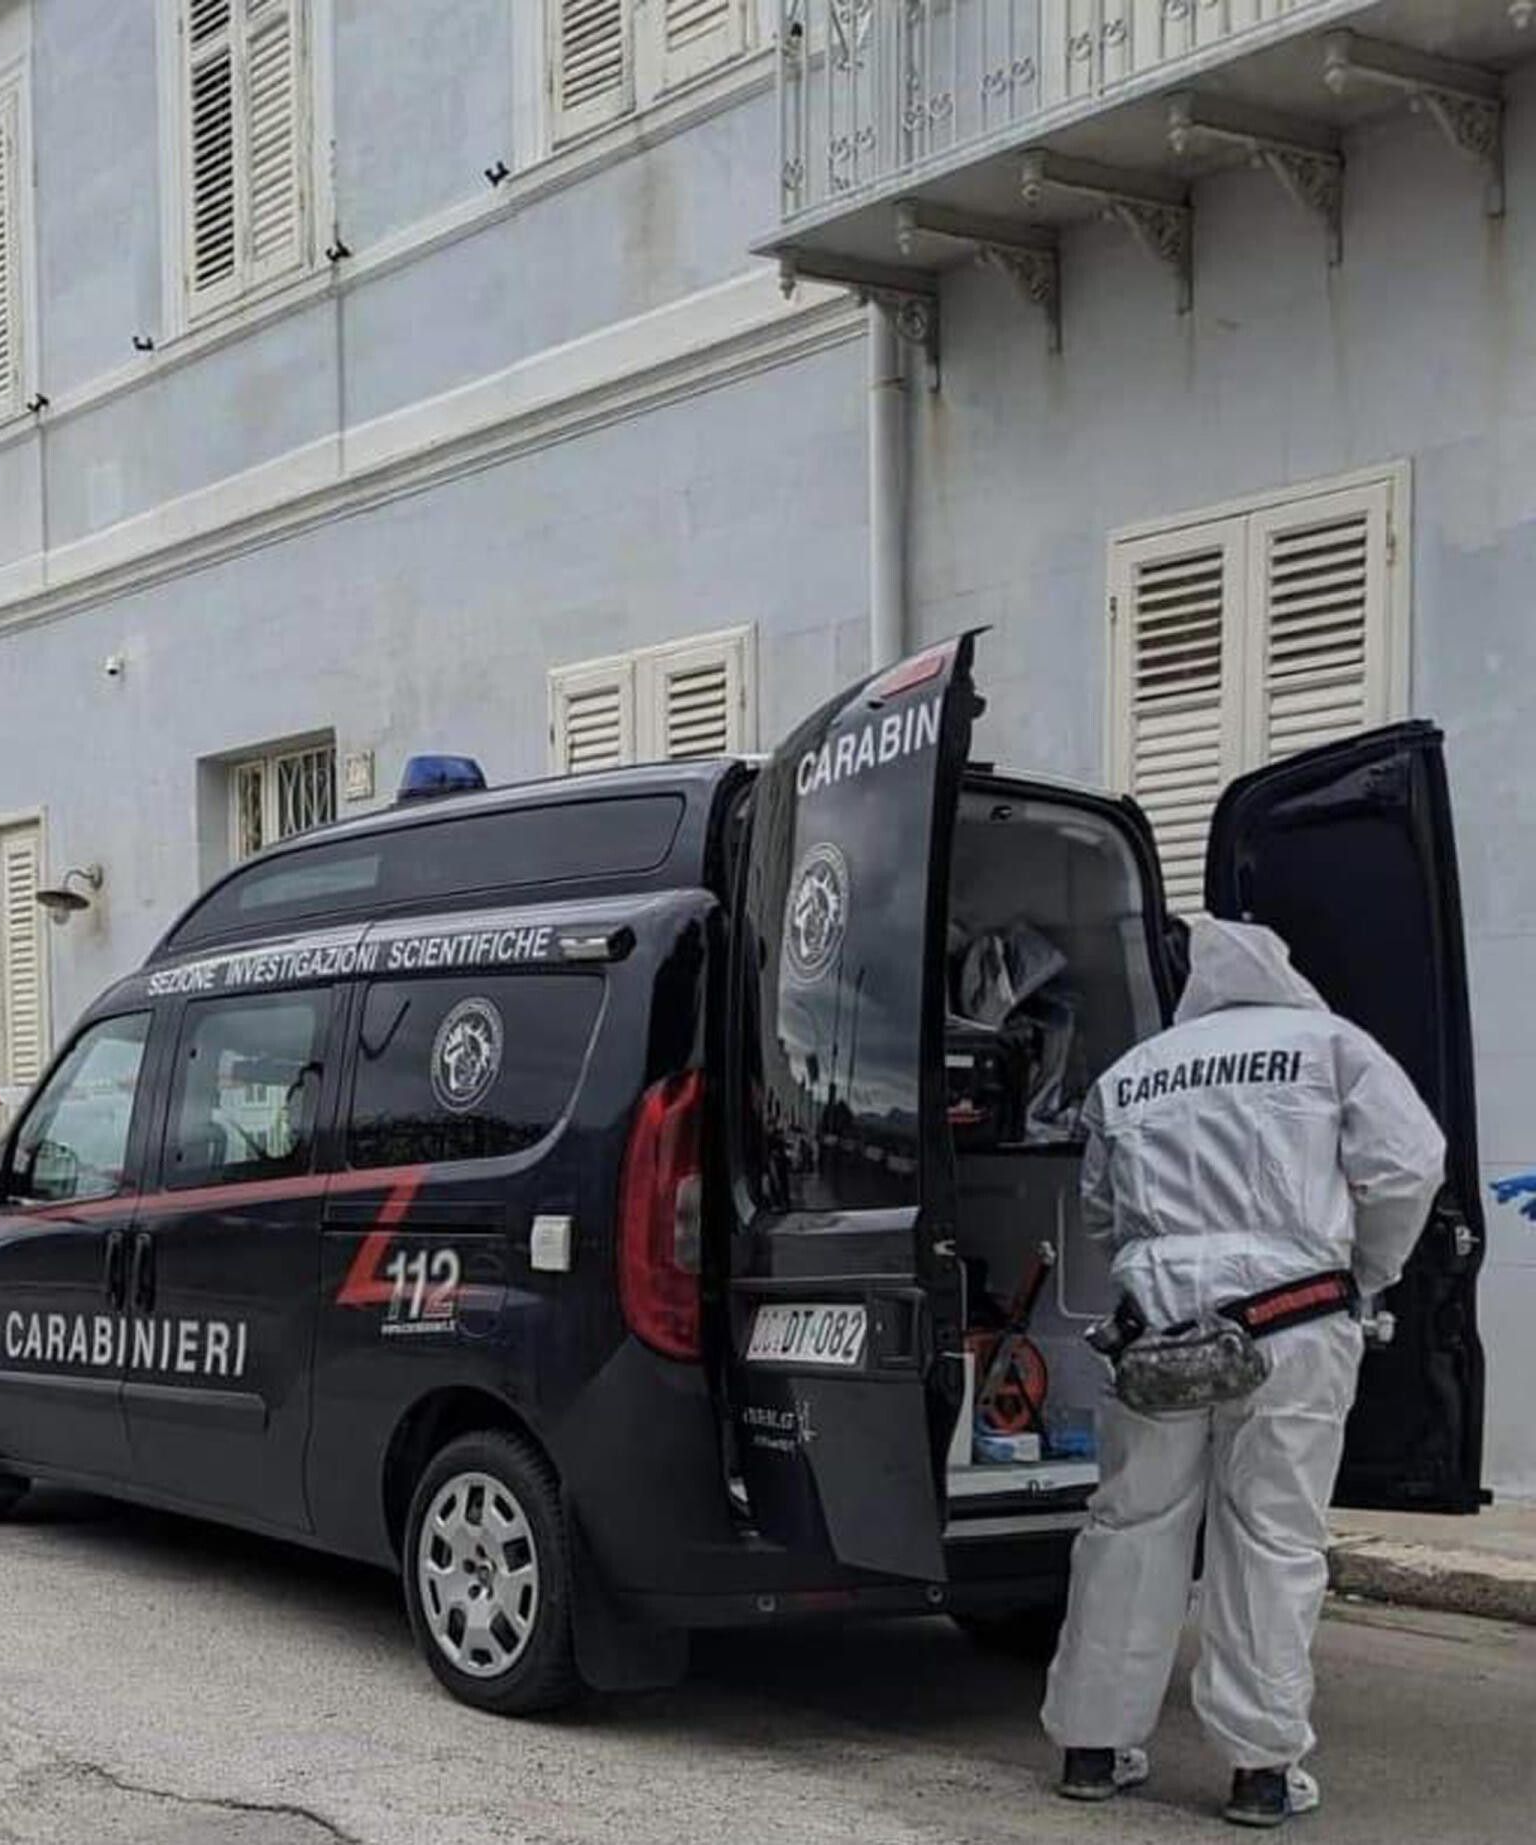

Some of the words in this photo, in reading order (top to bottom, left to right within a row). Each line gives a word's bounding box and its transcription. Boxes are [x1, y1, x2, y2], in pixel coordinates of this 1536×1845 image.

[796, 697, 944, 797] CARABIN
[146, 966, 217, 997] SEZIONE
[223, 945, 379, 987] INVESTIGAZIONI
[386, 927, 553, 970] SCIENTIFICHE
[1117, 1050, 1302, 1108] CARABINIERI
[386, 1248, 461, 1322] 112
[5, 1310, 247, 1377] CARABINIERI
